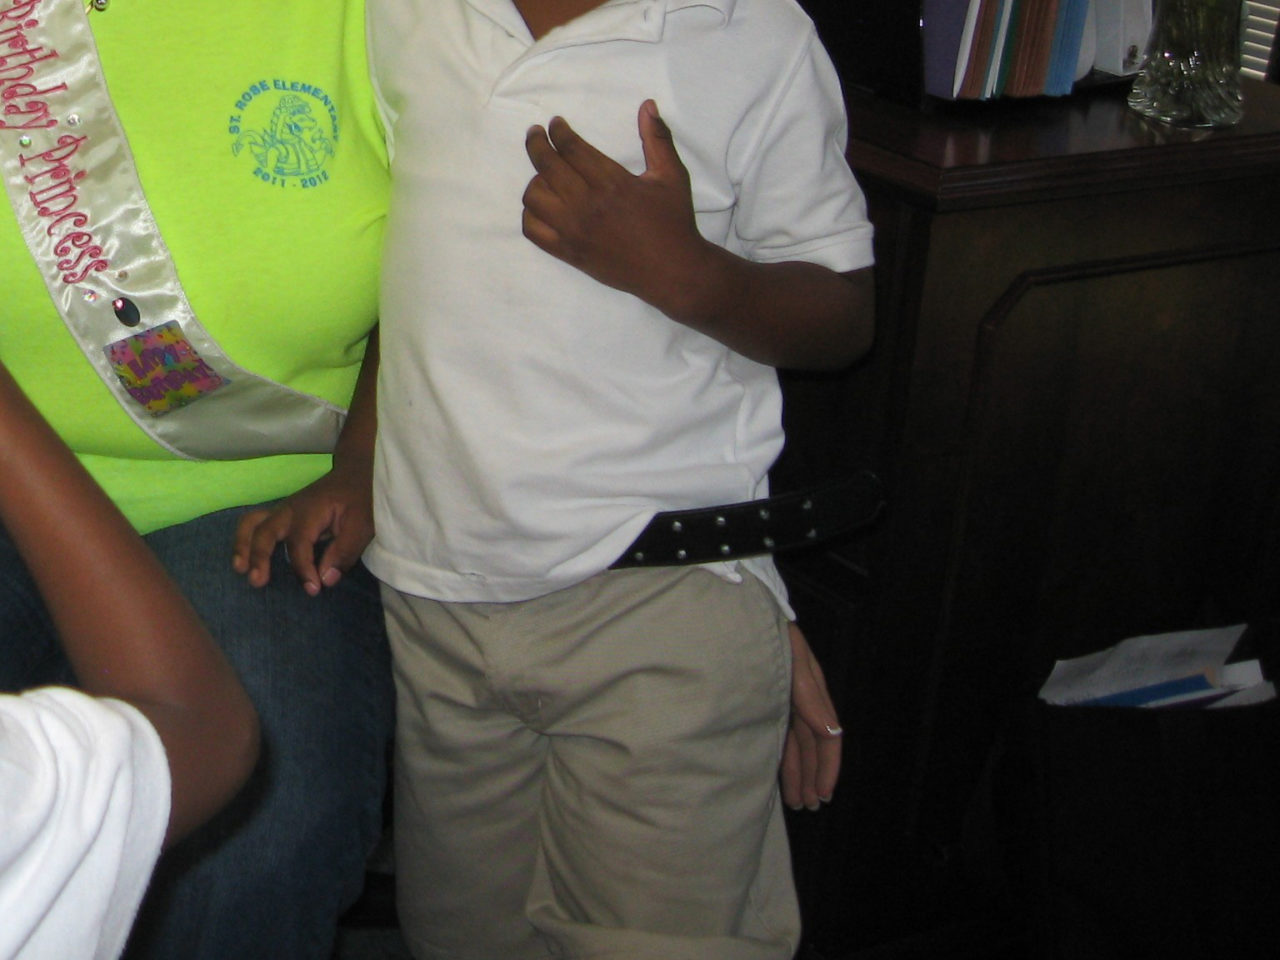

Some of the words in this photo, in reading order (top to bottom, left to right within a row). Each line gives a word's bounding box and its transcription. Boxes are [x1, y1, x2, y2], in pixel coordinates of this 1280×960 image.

[273, 79, 339, 141] ELEMENTARY
[253, 167, 286, 187] 2011
[300, 170, 329, 188] 2012
[18, 134, 109, 284] Princess
